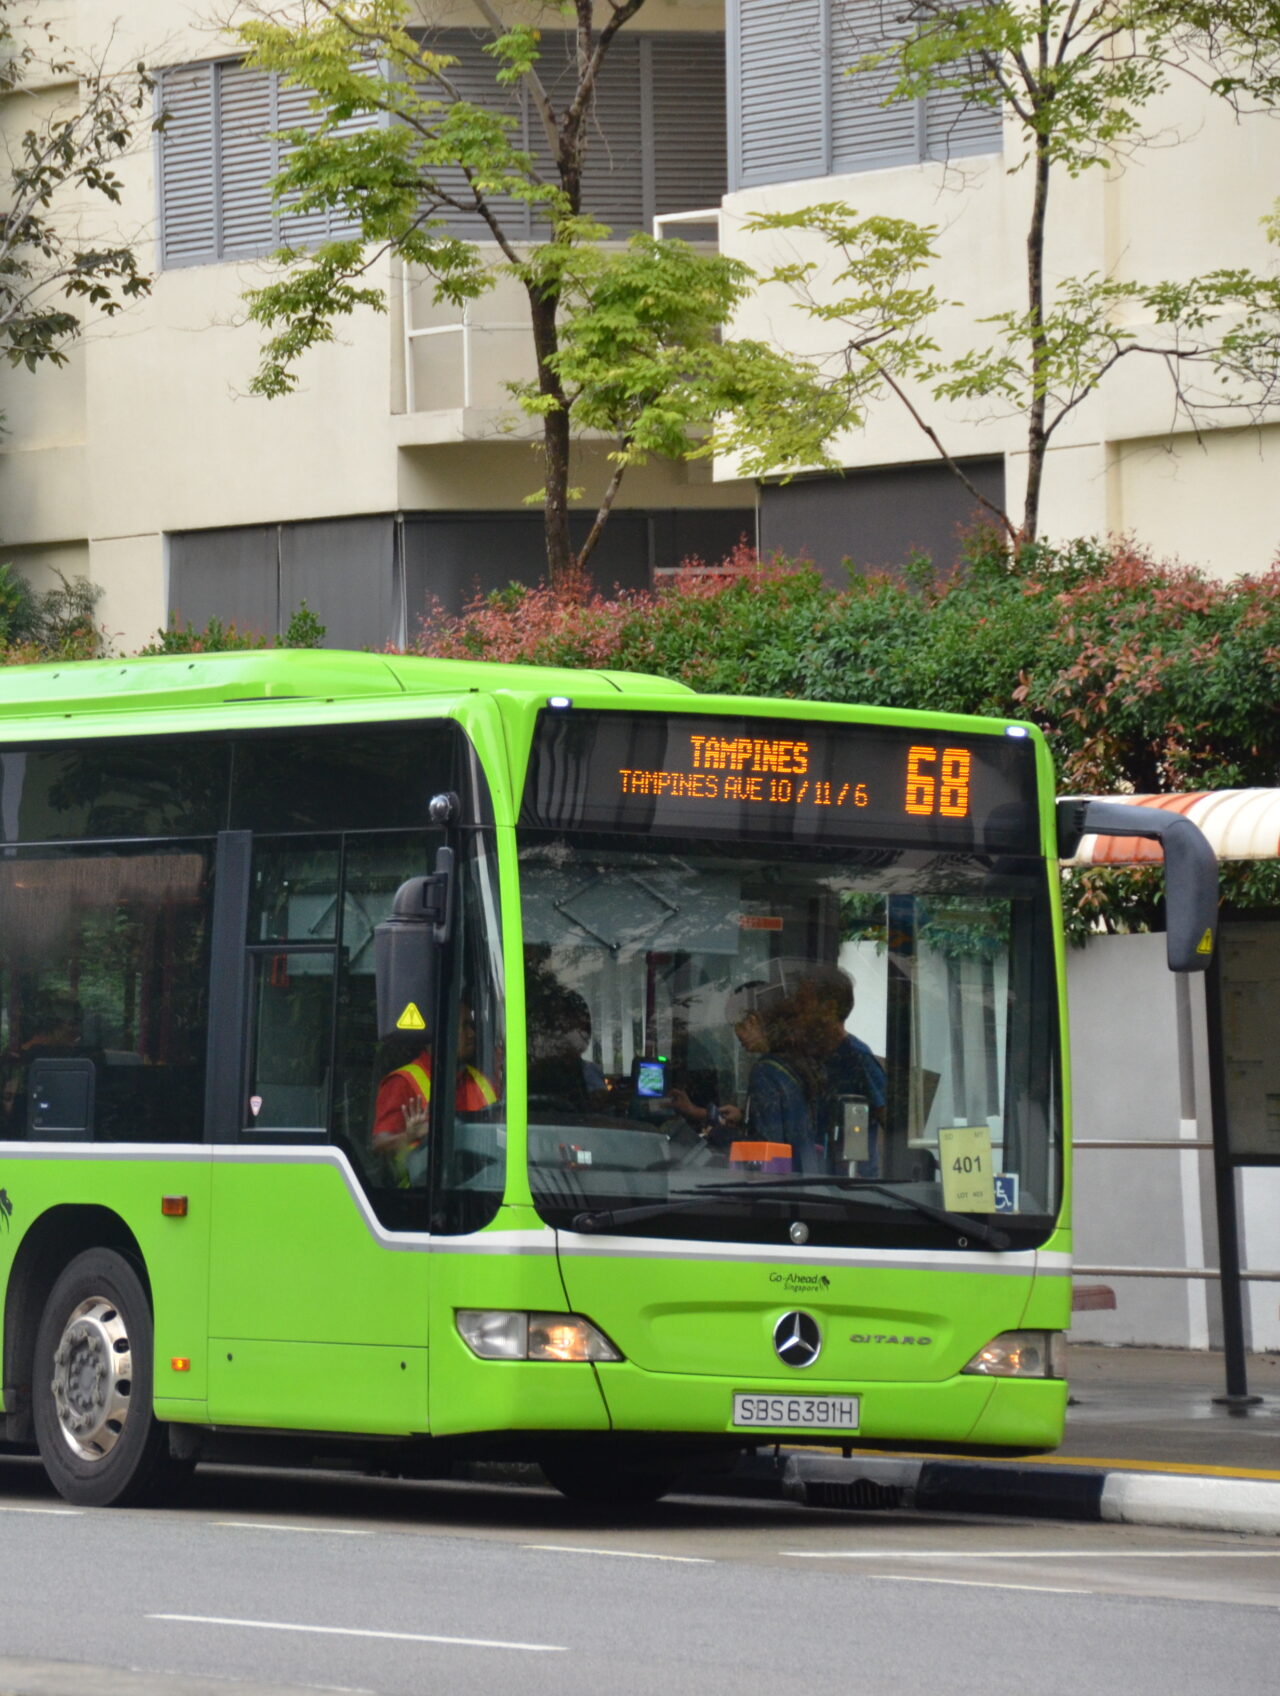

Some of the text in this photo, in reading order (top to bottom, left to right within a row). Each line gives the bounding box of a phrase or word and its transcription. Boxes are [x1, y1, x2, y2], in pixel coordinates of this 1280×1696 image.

[690, 735, 809, 774] TAMPINES
[619, 769, 719, 798] TAMPINES
[724, 776, 763, 801] AVE
[905, 746, 971, 817] 68
[952, 1155, 982, 1174] 401
[769, 1272, 818, 1284] Go-Ahead
[784, 1282, 819, 1292] Singapore
[849, 1334, 932, 1346] CITARO
[740, 1399, 853, 1424] SBS6391H
